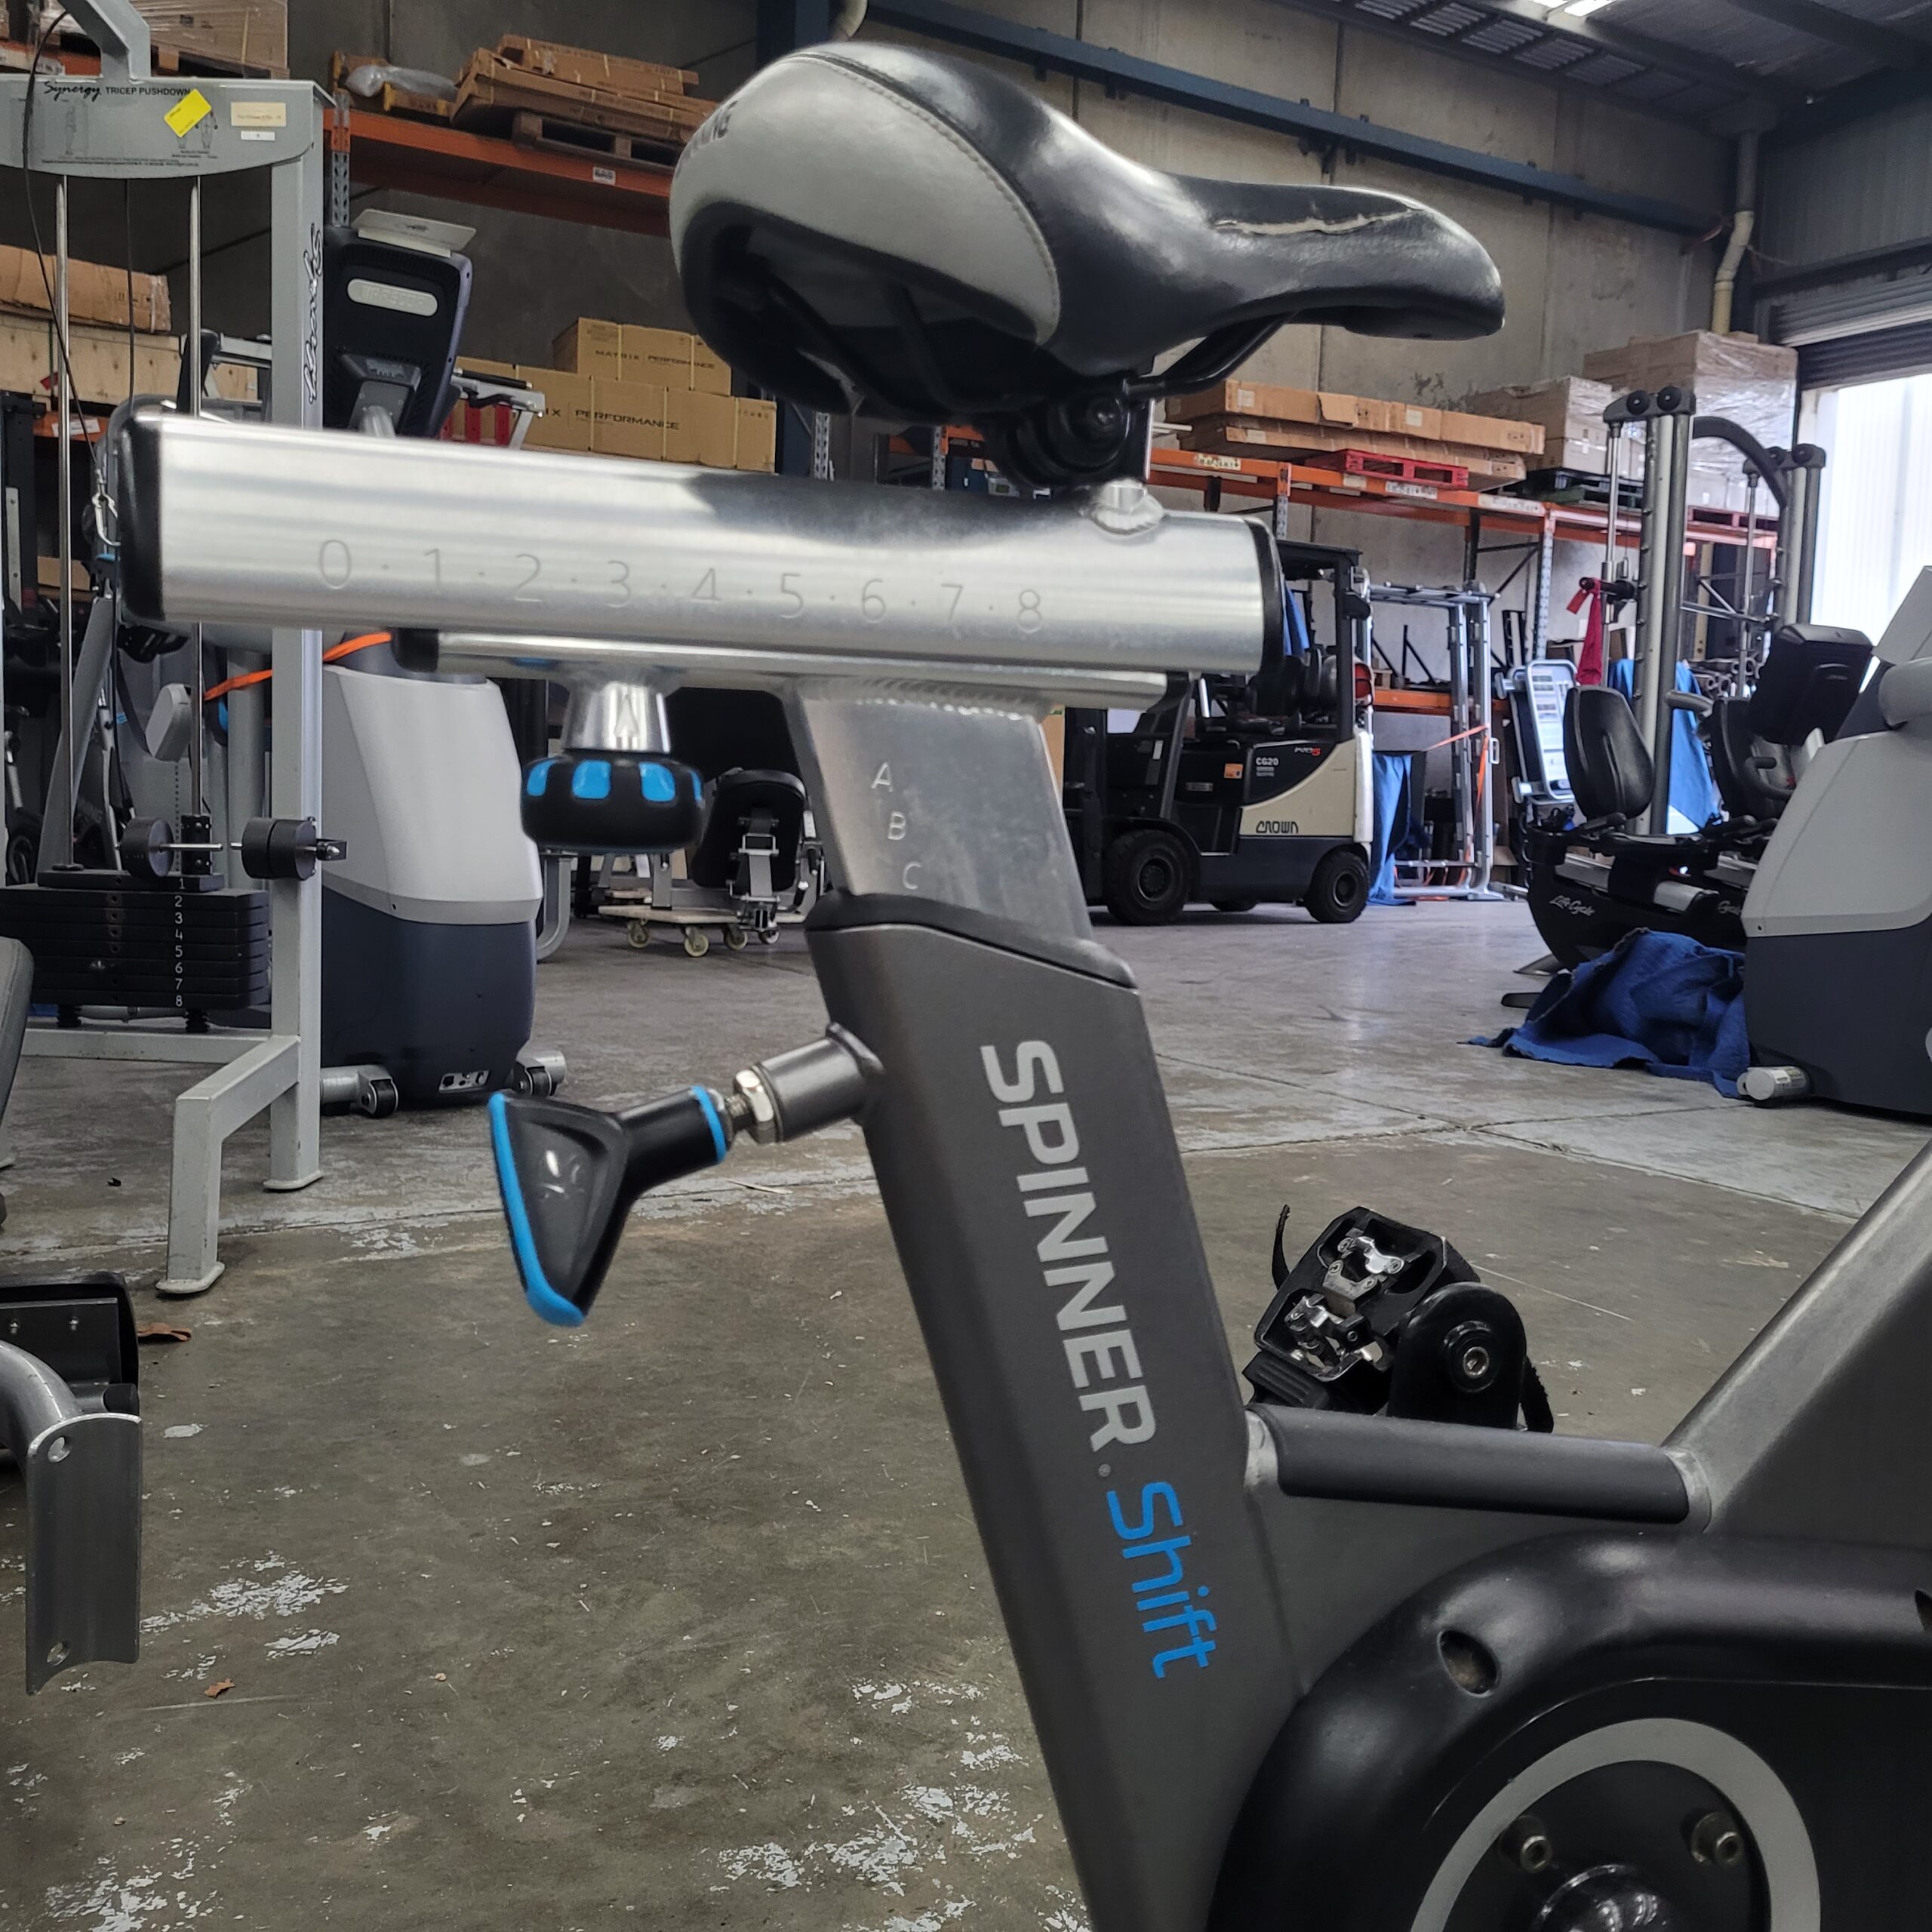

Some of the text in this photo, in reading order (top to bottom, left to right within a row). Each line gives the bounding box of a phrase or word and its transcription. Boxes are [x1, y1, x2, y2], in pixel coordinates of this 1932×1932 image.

[44, 81, 191, 102] Synergy TRICEP PUSHDOWN
[575, 410, 679, 430] PERFORMANCE
[318, 540, 1042, 633] 0 1 2 3 4 5 6 7 8
[1255, 757, 1279, 766] CG20
[871, 761, 894, 792] A
[888, 811, 906, 841] B
[1256, 820, 1299, 834] CROWN
[903, 861, 922, 890] C
[179, 878, 186, 890] 1
[174, 895, 183, 907] 2
[174, 912, 183, 924] 3
[175, 928, 183, 940] 4
[175, 945, 183, 958] 5
[175, 962, 183, 974] 6
[175, 978, 183, 990] 7
[175, 995, 183, 1007] 8
[981, 1040, 1217, 1679] SPINNER Shift
